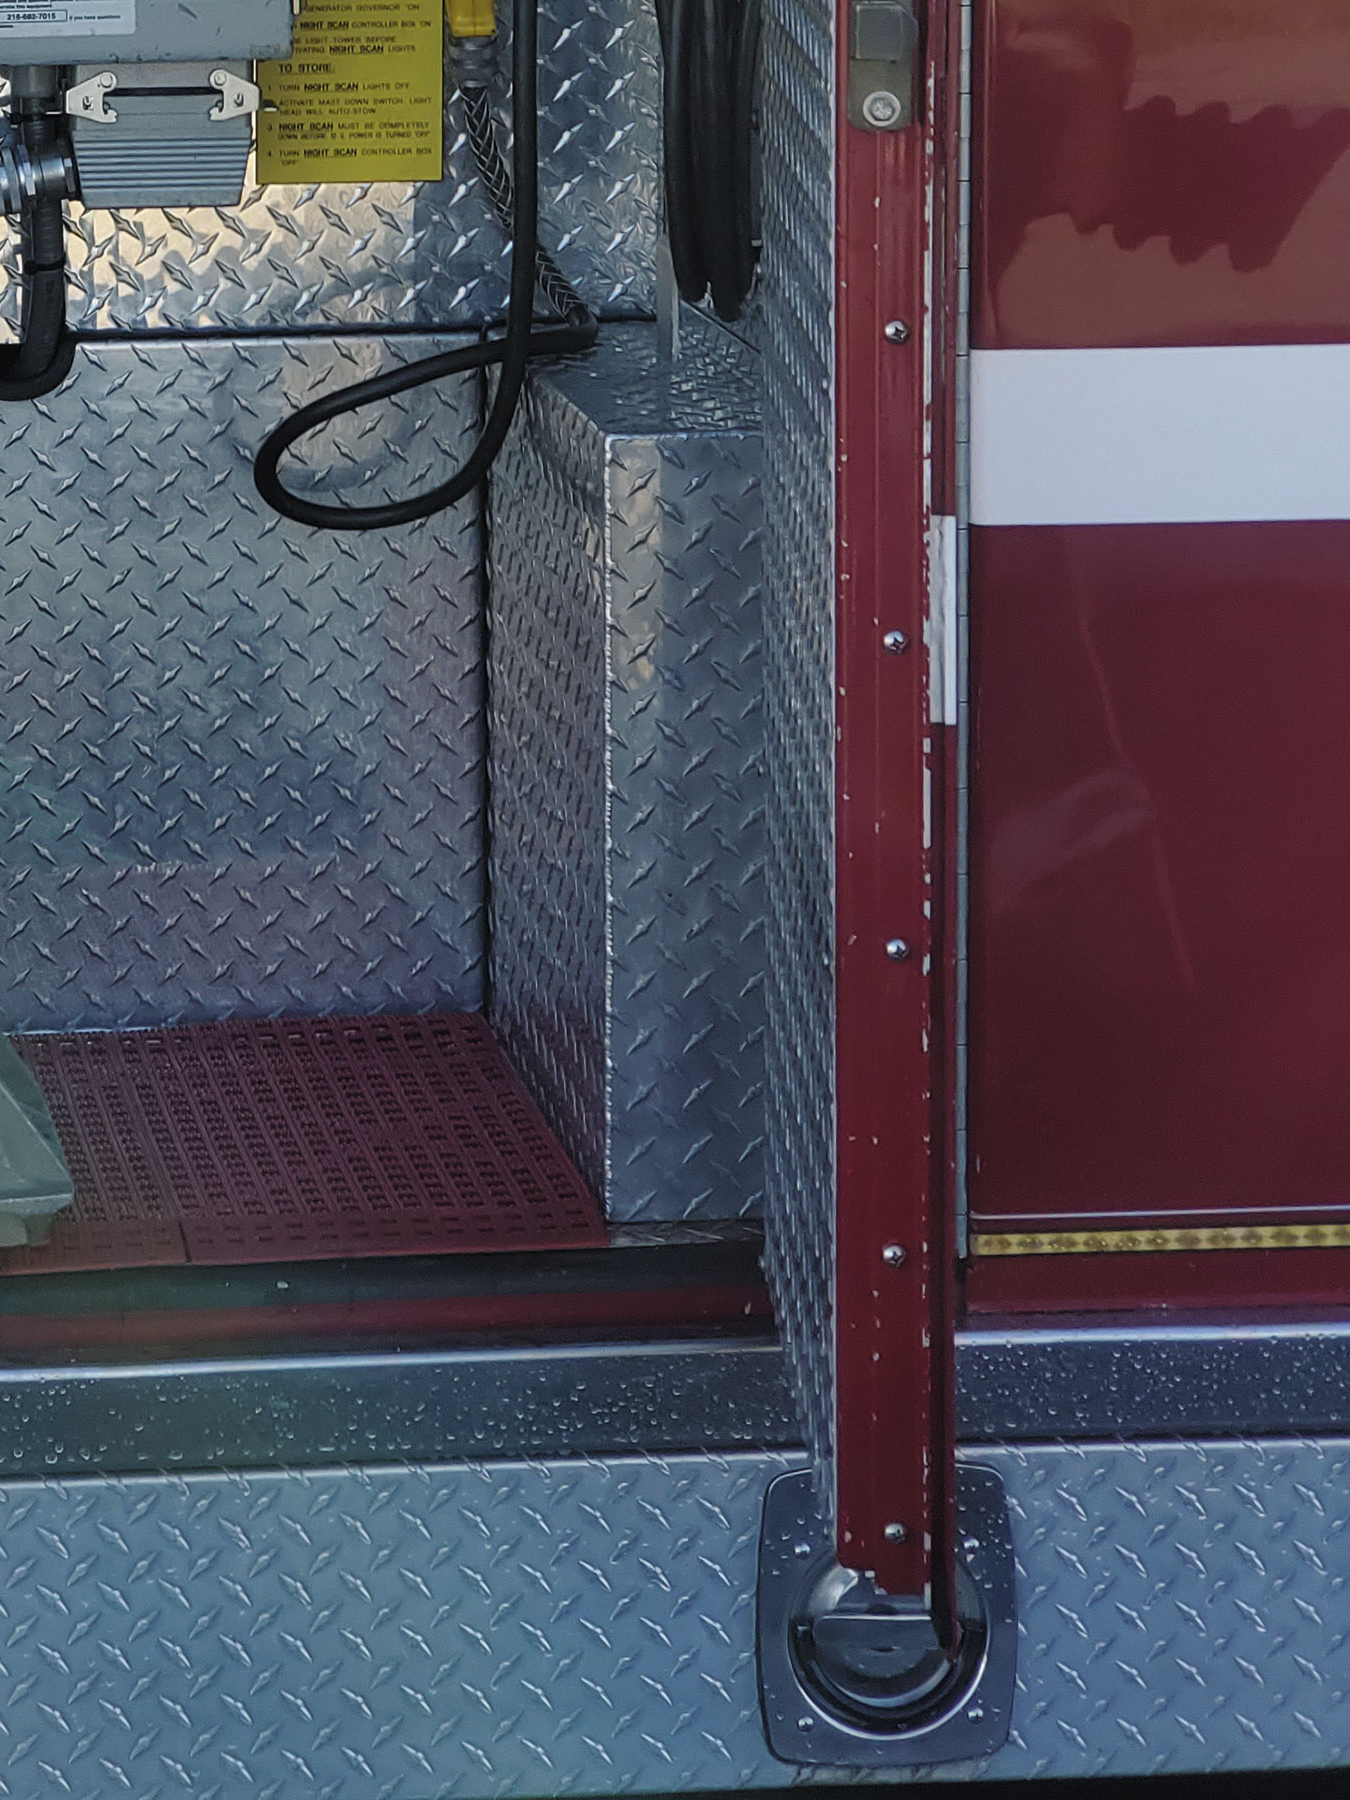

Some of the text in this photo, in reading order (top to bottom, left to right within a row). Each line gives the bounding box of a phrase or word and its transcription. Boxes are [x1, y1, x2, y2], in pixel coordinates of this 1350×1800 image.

[356, 4, 400, 12] GOVERNOR
[300, 21, 323, 30] NIGHT
[327, 21, 349, 29] SCAN
[401, 20, 415, 28] BOX
[329, 45, 354, 54] NIGHT
[360, 45, 384, 54] SCAN
[278, 63, 292, 73] TO
[279, 84, 300, 92] TURN
[304, 83, 330, 92] NIGHT
[334, 83, 358, 91] SCAN
[362, 83, 390, 91] LIGHTS
[279, 99, 314, 107] ACTIVATE
[318, 98, 340, 106] MAST
[345, 97, 369, 105] DOWN
[279, 108, 301, 116] HEAD
[279, 123, 304, 132] NIGHT
[309, 122, 334, 131] SCAN
[364, 122, 375, 130] BE
[378, 121, 430, 129] COMPLETELY
[349, 131, 373, 139] POWER
[385, 131, 411, 139] TURNED
[279, 149, 300, 157] TURN
[303, 149, 328, 158] NIGHT
[334, 148, 357, 157] SCAN
[361, 148, 412, 156] CONTROLLER
[416, 147, 432, 155] BOX
